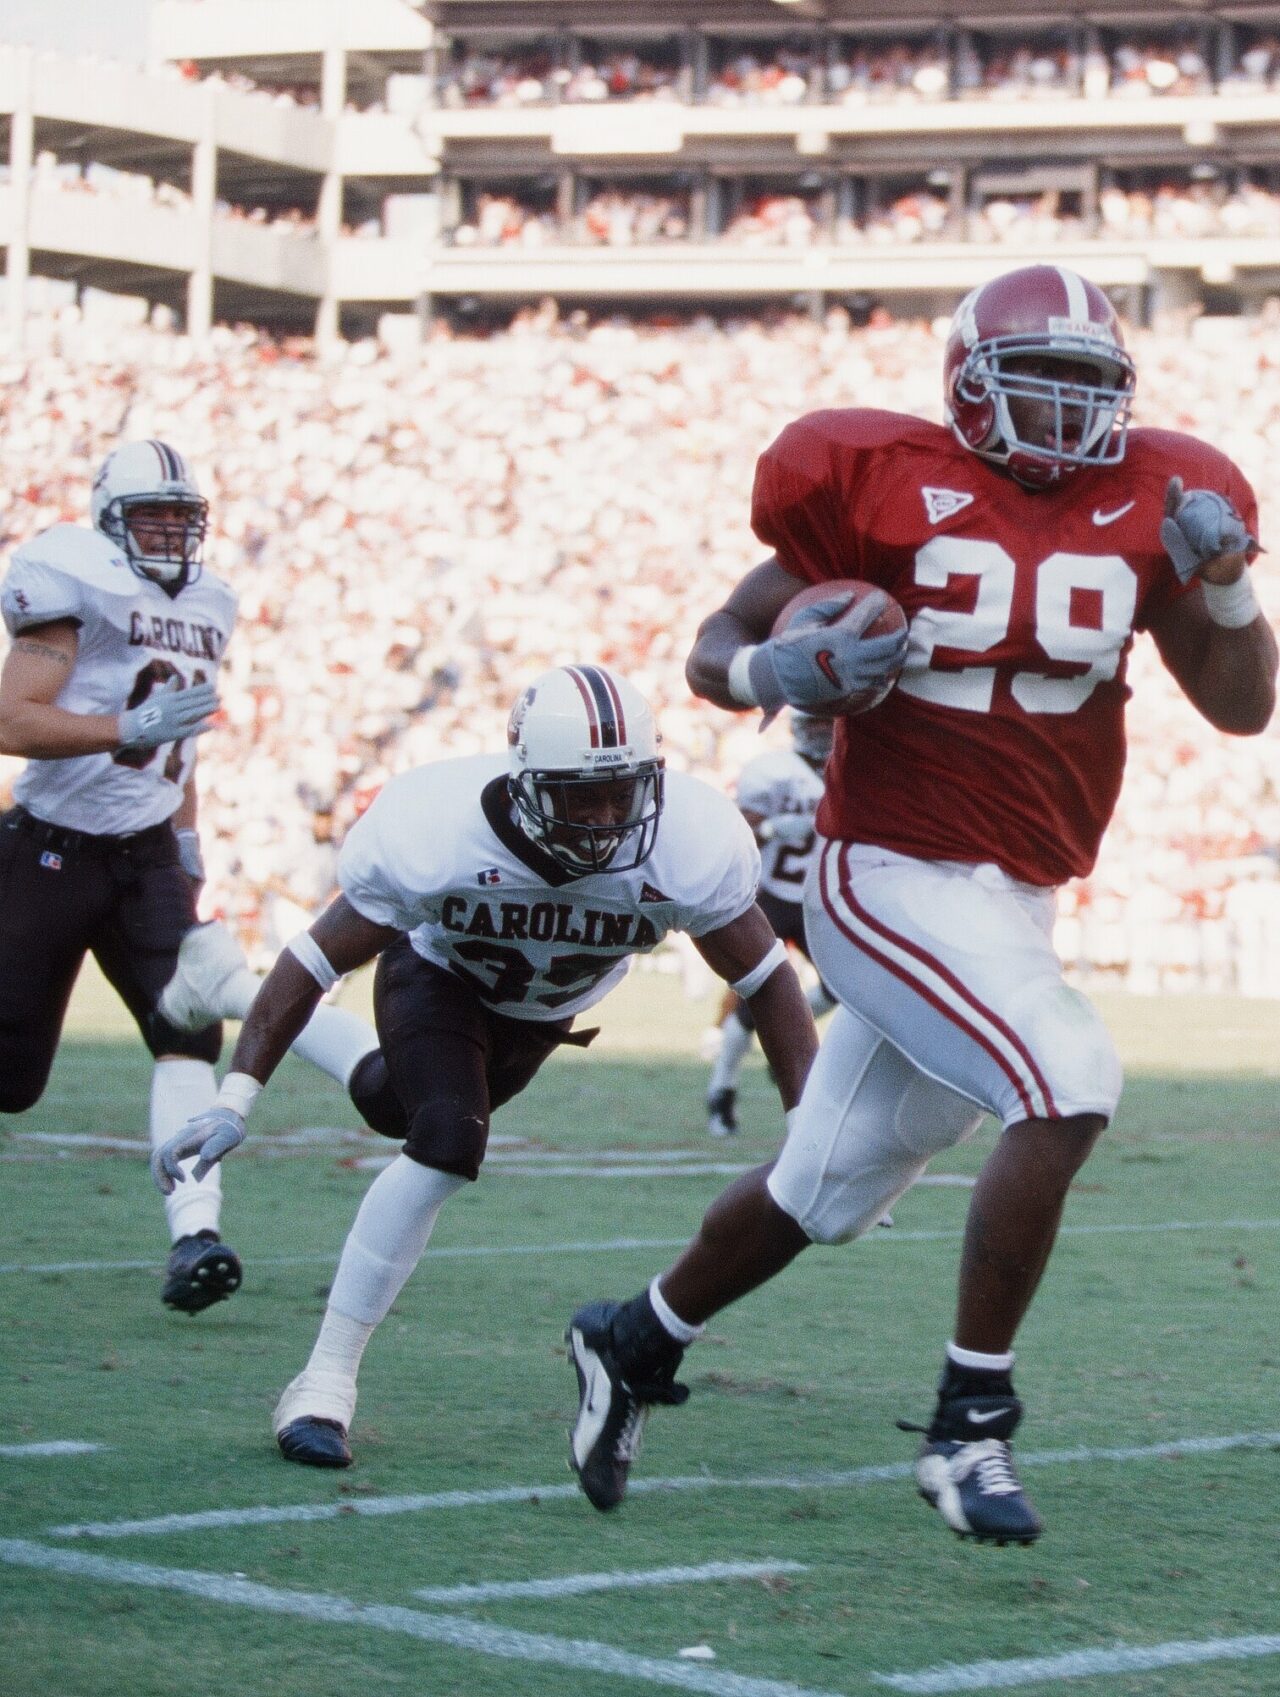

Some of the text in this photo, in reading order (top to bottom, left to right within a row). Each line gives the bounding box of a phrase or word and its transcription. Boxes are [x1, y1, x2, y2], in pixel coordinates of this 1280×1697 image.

[898, 535, 1138, 714] 29
[595, 754, 622, 764] CAROLINA
[441, 895, 659, 948] CAROLINA
